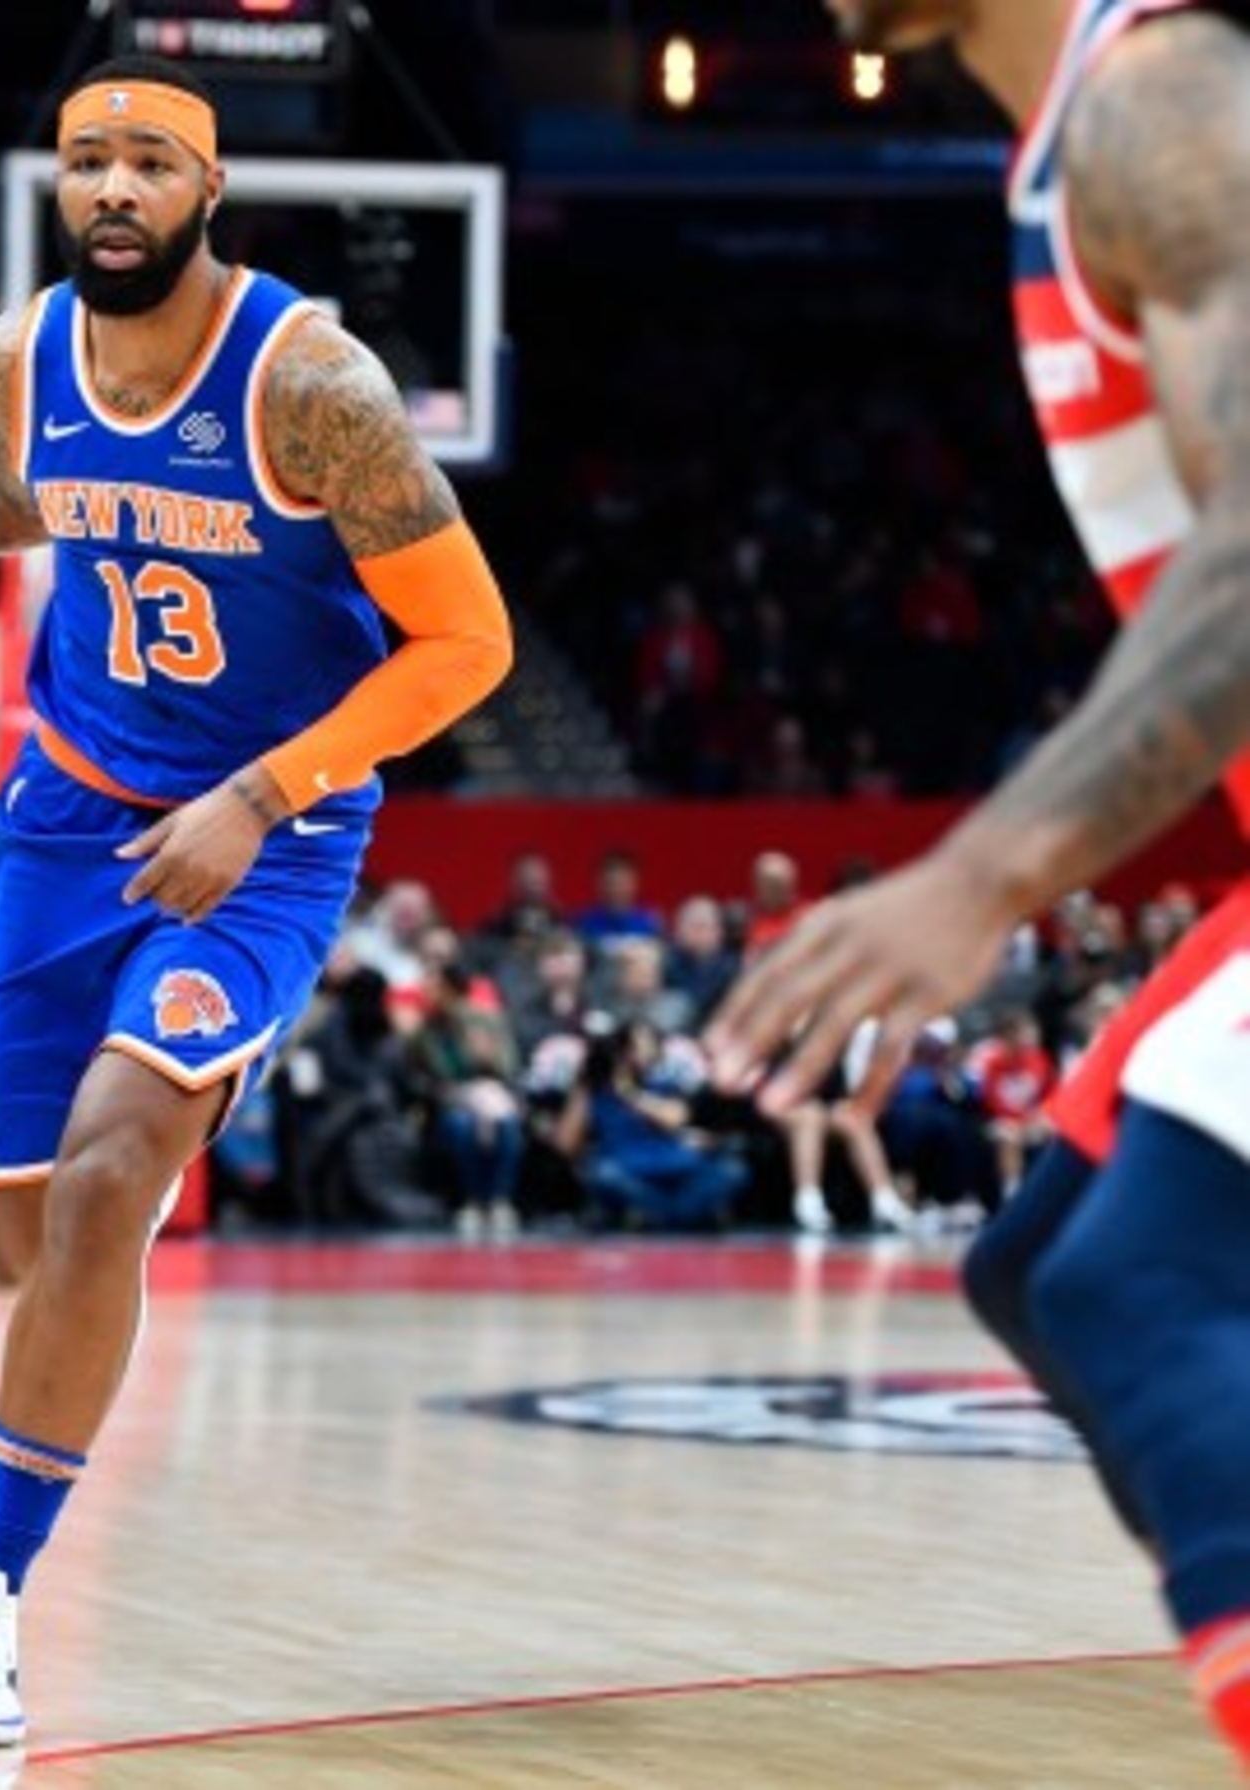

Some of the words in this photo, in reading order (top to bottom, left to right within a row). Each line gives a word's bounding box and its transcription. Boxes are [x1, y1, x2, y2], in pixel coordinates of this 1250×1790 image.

[35, 481, 119, 539] NEW
[120, 483, 262, 553] YORK
[96, 561, 225, 686] 13
